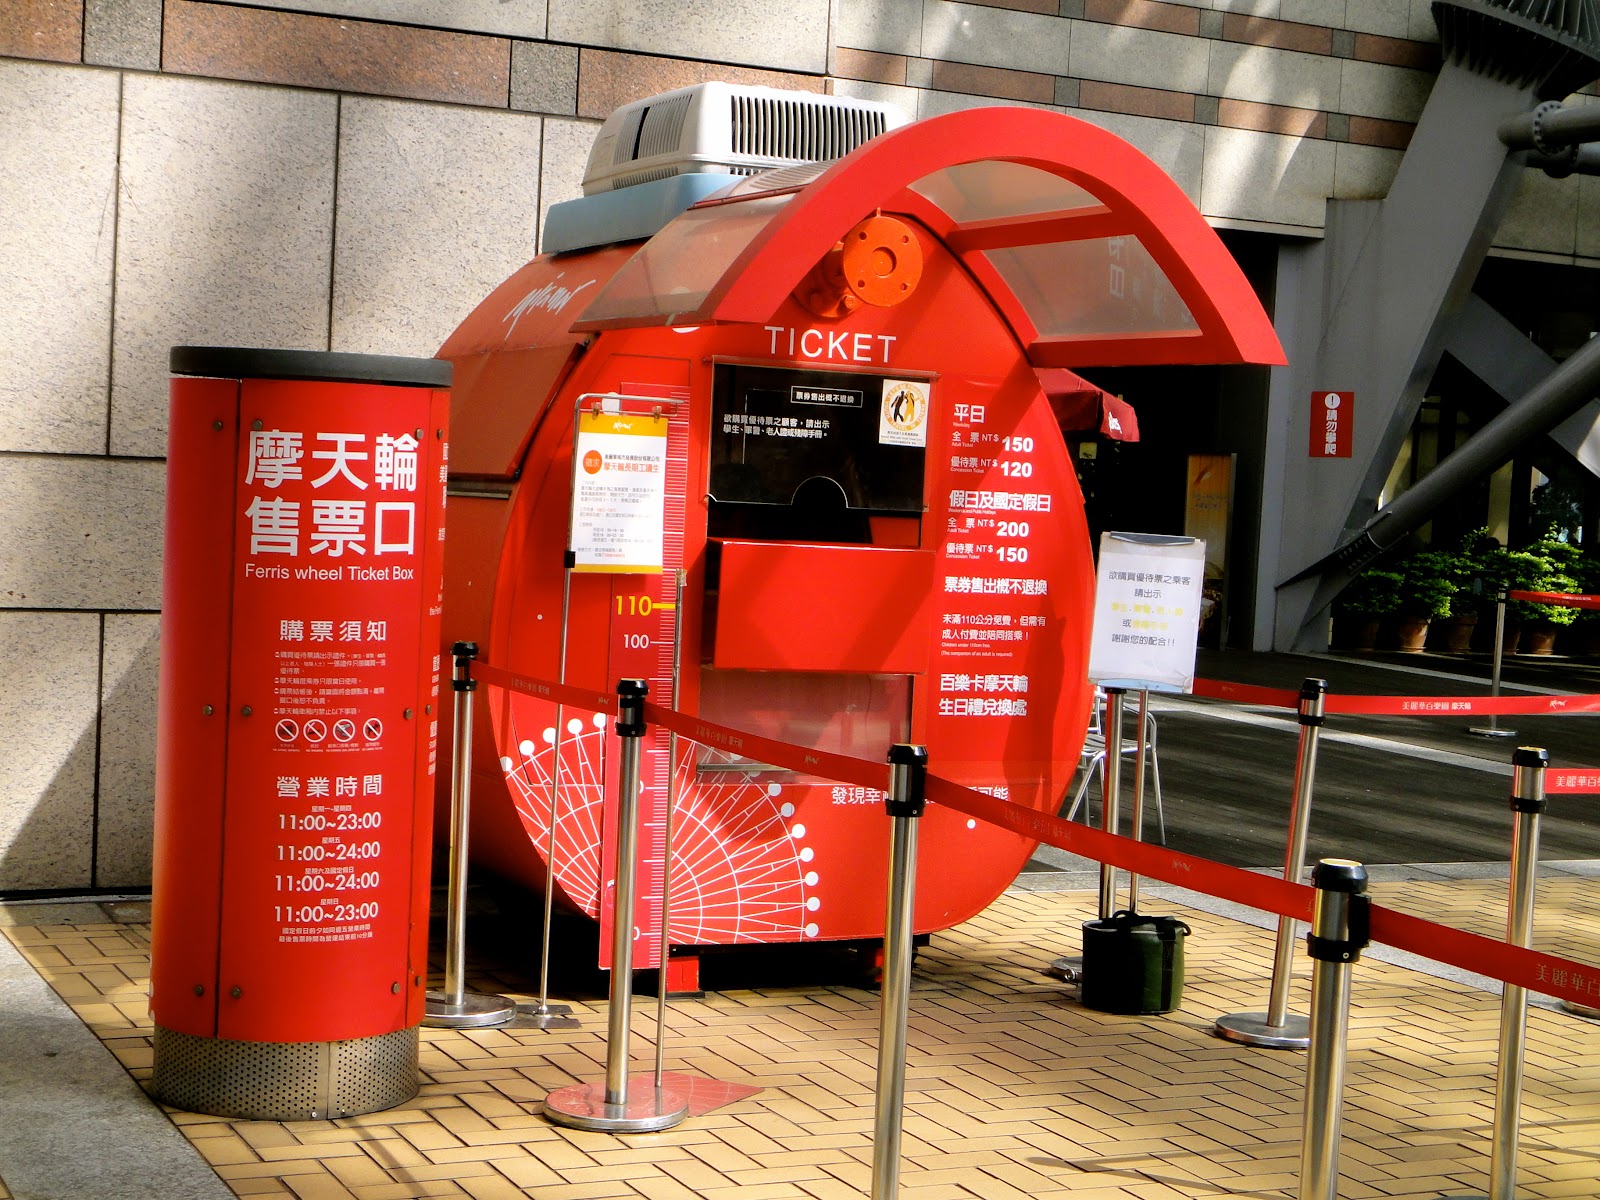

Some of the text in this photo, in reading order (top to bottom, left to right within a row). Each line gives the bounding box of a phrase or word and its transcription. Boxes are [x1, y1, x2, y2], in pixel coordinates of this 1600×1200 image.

[764, 325, 897, 363] TICKET
[954, 403, 985, 424] 平日
[1324, 409, 1338, 455] 請勿攀爬
[981, 433, 1000, 442] NT$
[1002, 436, 1034, 453] 150
[245, 429, 419, 491] 摩天輪
[951, 456, 1032, 477] 優待票 NT$ 120
[949, 489, 1051, 512] 假日及國定假日
[244, 495, 416, 557] 售票口
[977, 519, 995, 528] NT$
[996, 521, 1030, 538] 200
[946, 542, 1028, 563] 優待票 NT$ 150
[245, 563, 414, 581] Ferris wheel Ticket Box
[1108, 570, 1191, 586] 欲購買優待票之乘客
[944, 576, 1048, 596] 票券售出概不退換
[1134, 588, 1162, 599] 請出示
[616, 595, 652, 616] 110
[279, 619, 387, 642] 購票須知
[1111, 633, 1175, 647] 謝謝您的配合!!
[624, 634, 649, 649] 100
[940, 674, 1028, 692] 百樂卡摩天輪
[938, 699, 1027, 716] 生日禮兌換處
[277, 774, 383, 798] 營業時間
[279, 812, 382, 831] 11:00~23:00
[278, 841, 381, 861] 11:00~24:00
[275, 872, 380, 892] 11:00~24:00
[275, 902, 379, 923] 11:00~23:00
